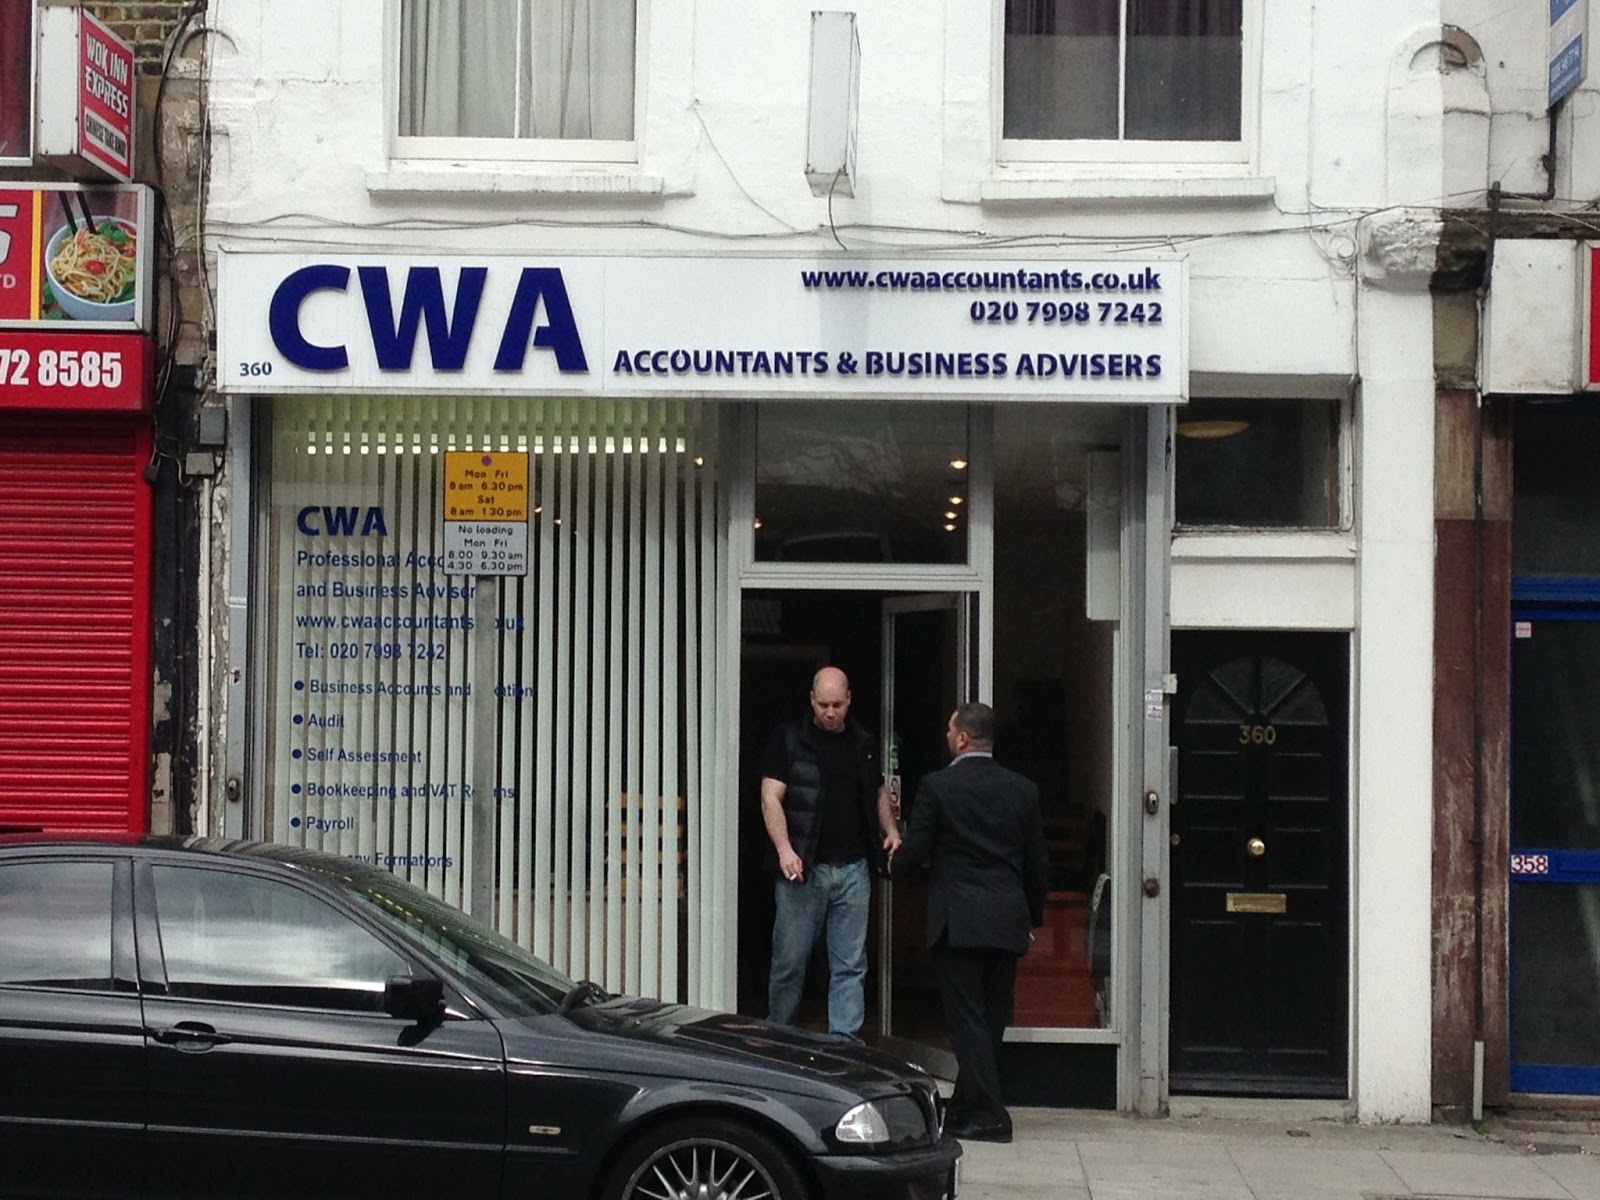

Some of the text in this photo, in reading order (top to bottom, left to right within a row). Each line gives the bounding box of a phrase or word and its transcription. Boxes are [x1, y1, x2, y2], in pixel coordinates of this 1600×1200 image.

[86, 34, 128, 86] WOK INN
[85, 65, 129, 119] EXPRESS
[801, 267, 1162, 291] www.cwaaccountants.co.uk
[269, 264, 589, 372] CWA
[970, 301, 1162, 323] 020 7998 7242
[37, 349, 123, 389] 8585
[239, 361, 273, 377] 360
[613, 350, 1162, 377] ACCOUNTANTS & BUSINESS ADVISERS
[465, 469, 509, 478] Mon Fri
[449, 481, 456, 490] 8
[507, 483, 524, 492] pm
[477, 494, 495, 504] Sat
[450, 506, 457, 515] 8
[506, 508, 522, 517] pm
[297, 506, 388, 536] CWA
[458, 525, 513, 535] No loading
[464, 538, 508, 548] Mon Fri
[297, 551, 401, 567] Professional
[448, 550, 523, 560] 8.00 9.30 am
[447, 561, 523, 572] 4.30 6.30 pm
[297, 583, 326, 598] and
[332, 582, 409, 599] Business
[296, 643, 325, 659] Tel:
[330, 643, 358, 659] 020
[364, 643, 402, 659] 7998
[310, 679, 373, 695] Business
[378, 681, 441, 696] Accounts
[446, 682, 471, 697] and
[308, 714, 345, 728] Audit
[1239, 725, 1276, 745] 360
[308, 748, 422, 764] Self Assessment
[308, 783, 397, 799] Bookkeeping
[401, 784, 426, 798] and
[430, 784, 457, 799] VAT
[307, 816, 354, 833] Payroll
[375, 852, 453, 868] Formations
[1513, 856, 1547, 872] 358
